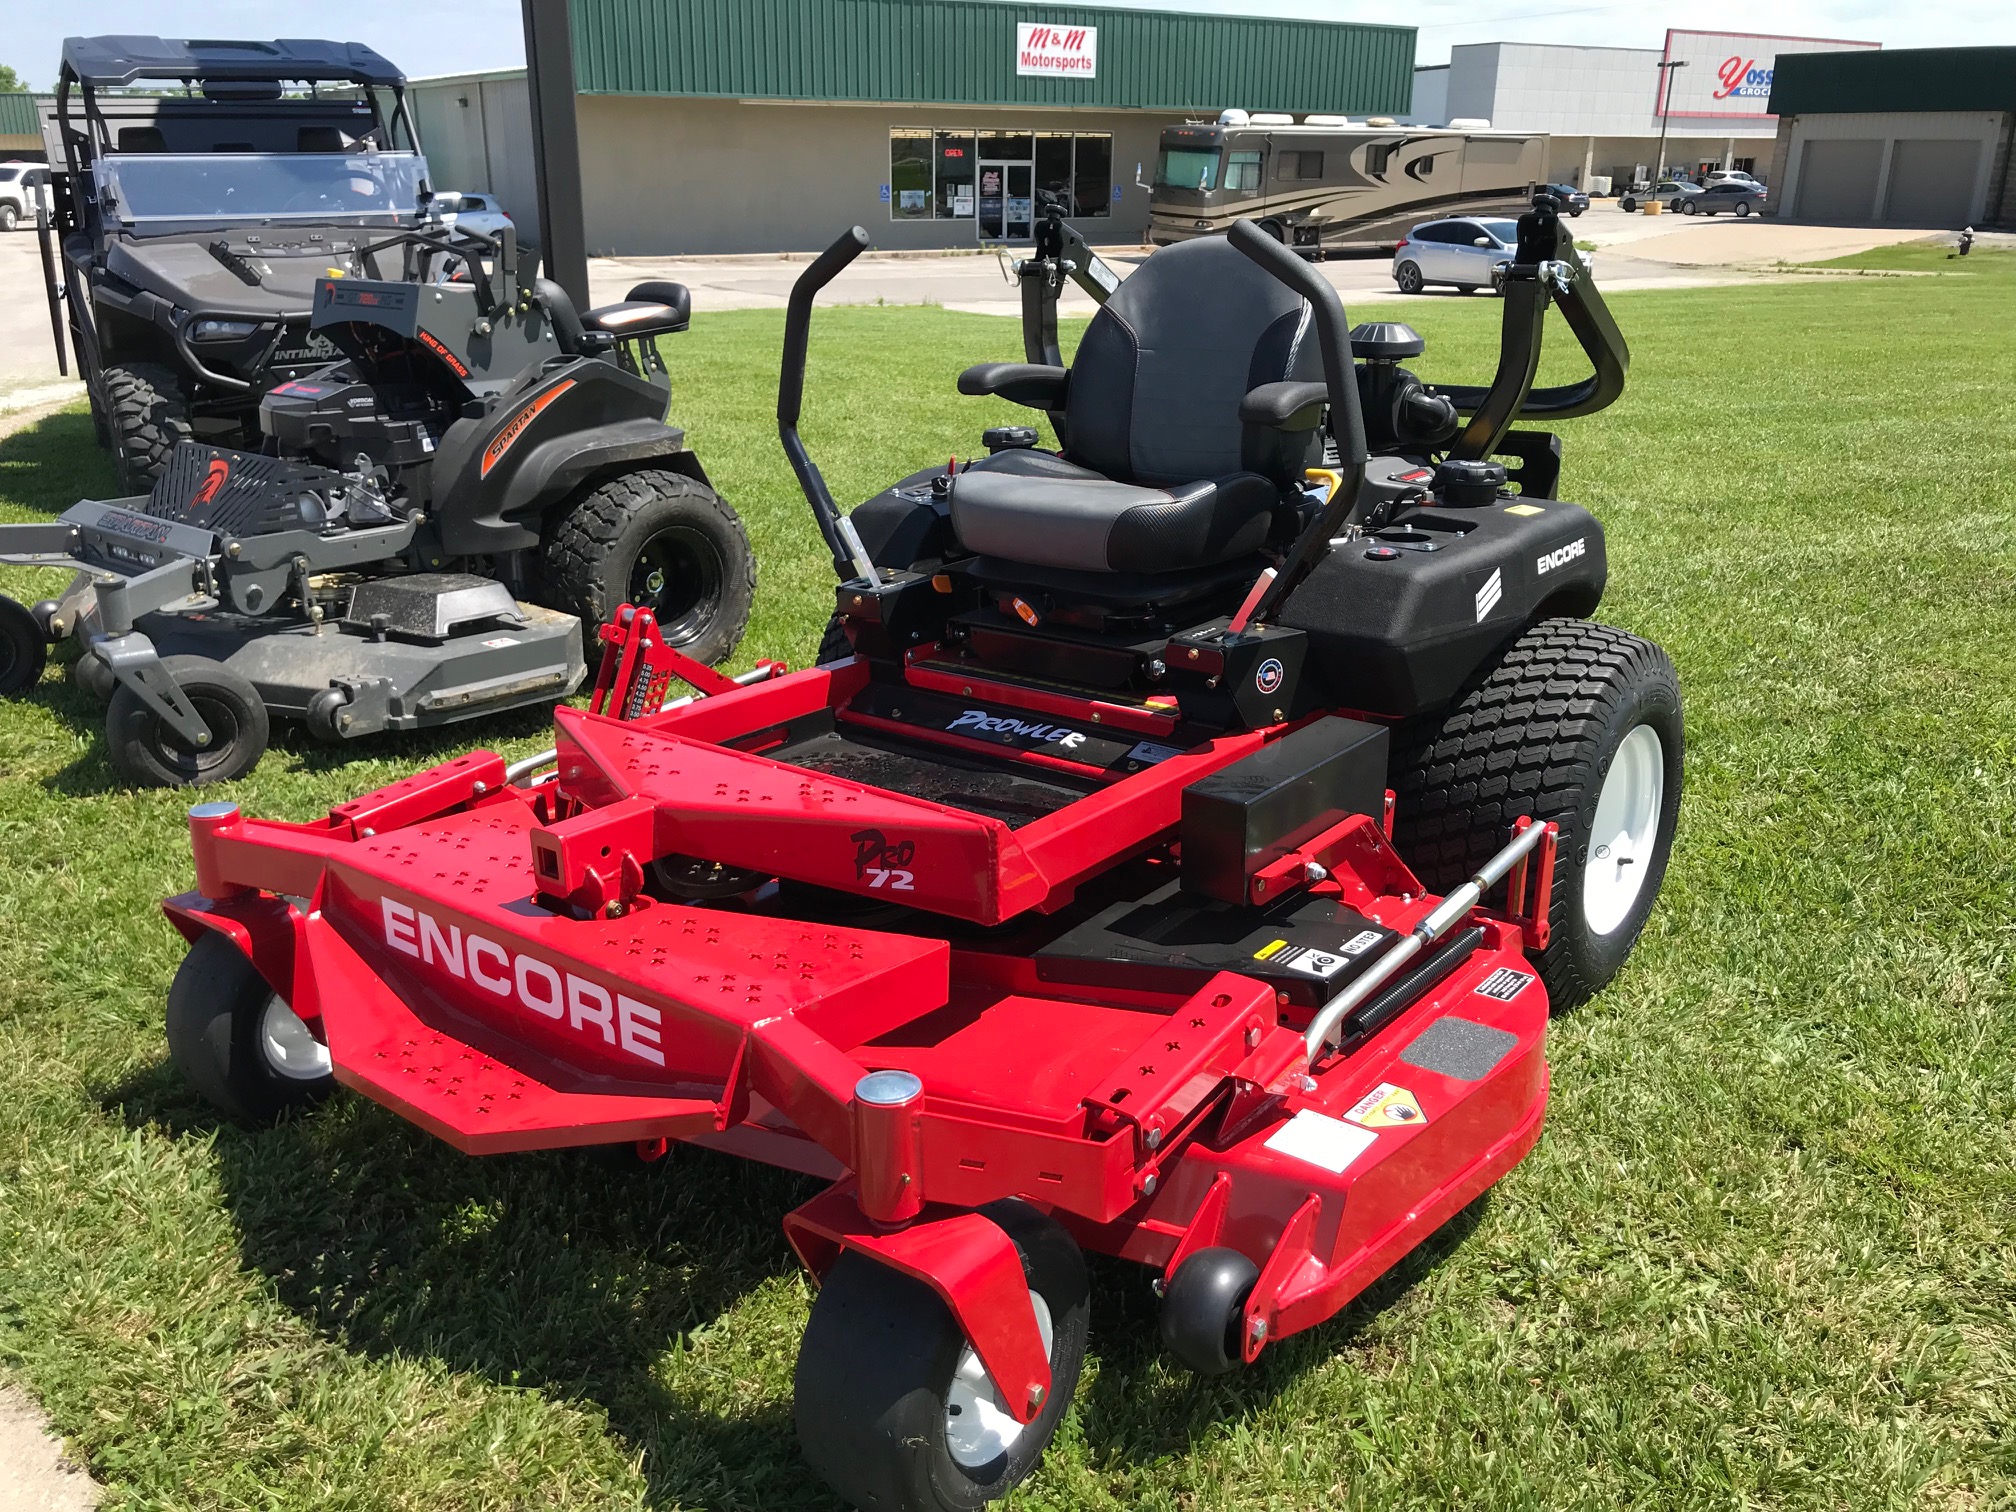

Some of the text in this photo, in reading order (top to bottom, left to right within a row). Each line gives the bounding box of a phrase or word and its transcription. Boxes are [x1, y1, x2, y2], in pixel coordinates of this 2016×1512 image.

[1027, 27, 1086, 51] M & M
[1021, 51, 1092, 71] Motorsports
[944, 149, 964, 157] OPEN
[420, 331, 468, 377] KING OF GRASS
[492, 404, 537, 459] SPARTAN
[97, 510, 172, 541] SPARTAN
[1537, 538, 1586, 575] ENCORE
[946, 710, 1087, 748] PROWLER
[866, 868, 915, 891] 72
[1344, 932, 1376, 953] NO STEP
[381, 896, 666, 1067] ENCORE
[1354, 1089, 1386, 1115] DANGER
